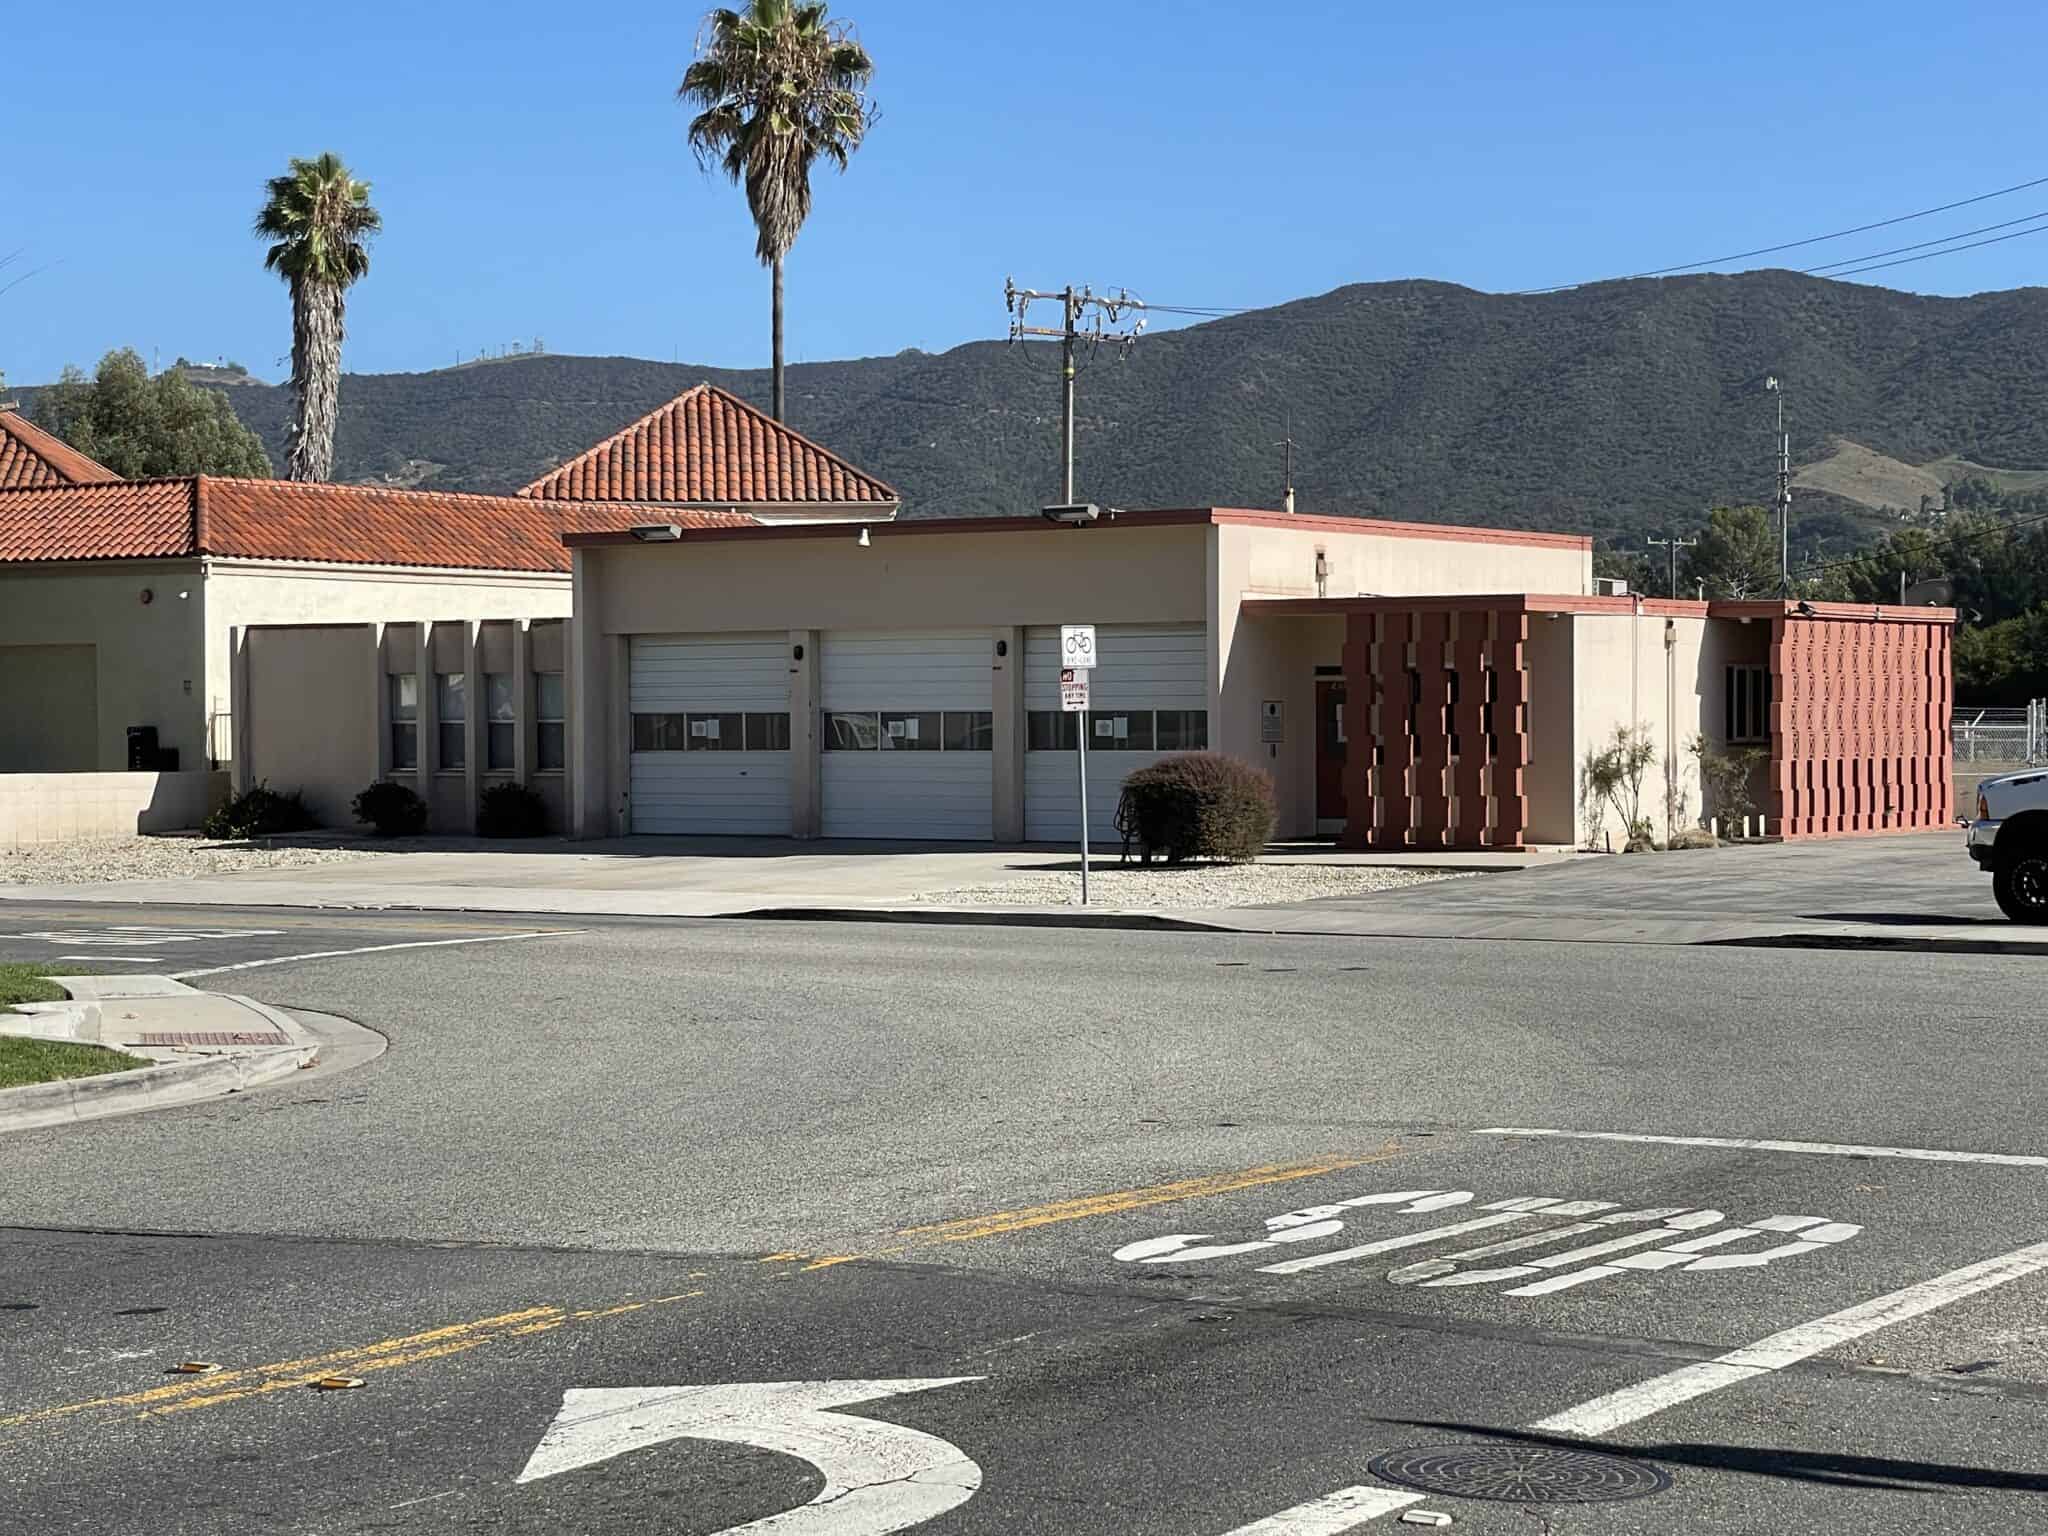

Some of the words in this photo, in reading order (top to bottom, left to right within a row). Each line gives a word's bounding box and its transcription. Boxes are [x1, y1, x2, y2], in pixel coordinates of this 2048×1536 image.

[1062, 671, 1072, 681] NO
[1062, 684, 1088, 692] STOPPING
[1112, 1190, 1863, 1297] STOP
